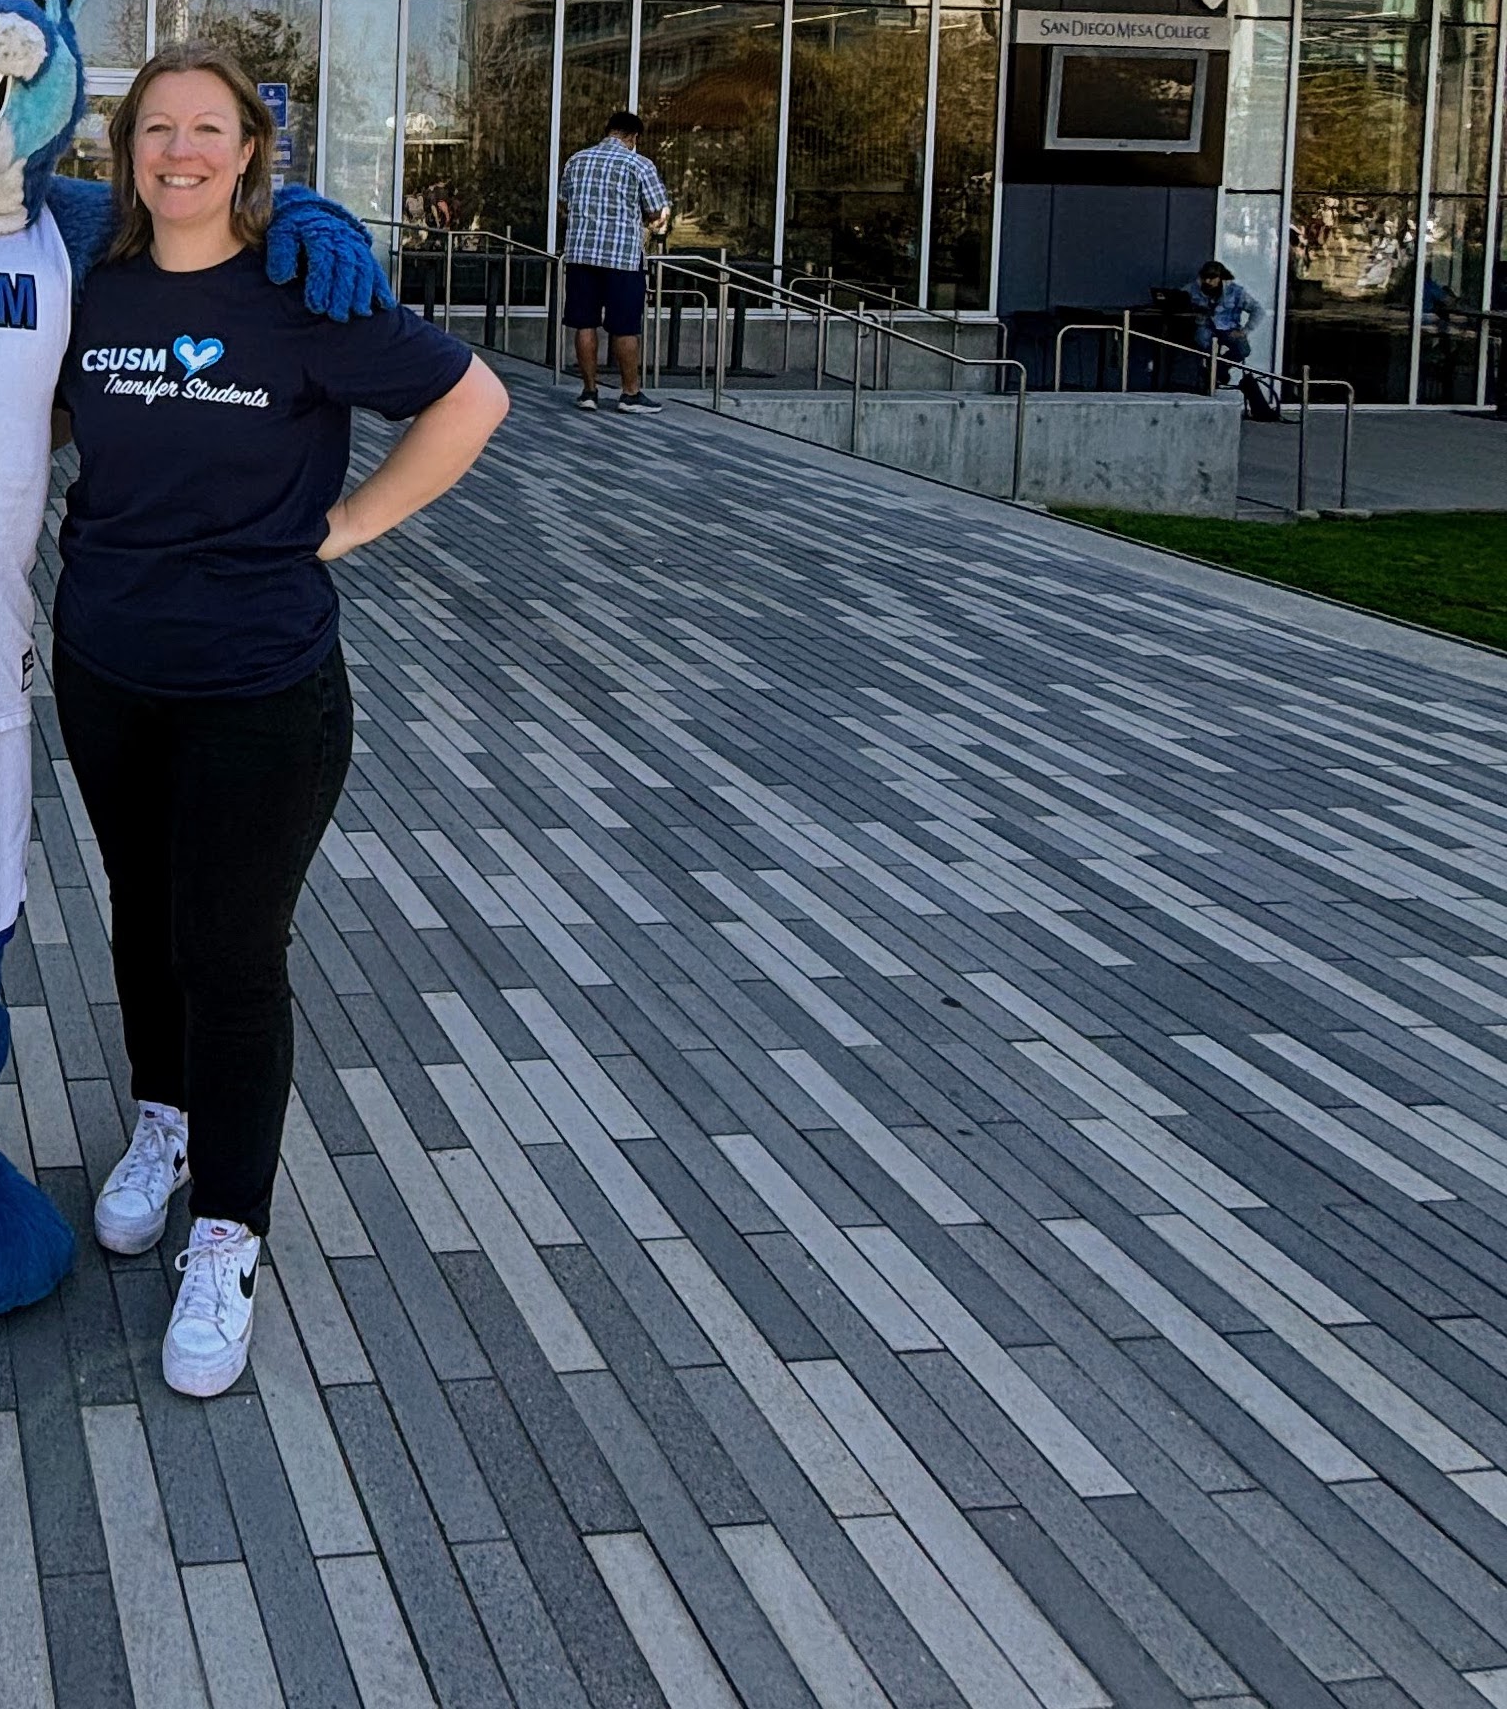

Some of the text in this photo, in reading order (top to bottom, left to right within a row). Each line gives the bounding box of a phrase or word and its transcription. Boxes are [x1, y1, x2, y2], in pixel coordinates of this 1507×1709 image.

[1040, 18, 1211, 39] SAN DIEGO MESA COLLEGE
[82, 347, 167, 373] CSUSM
[103, 373, 270, 408] Transfer Students
